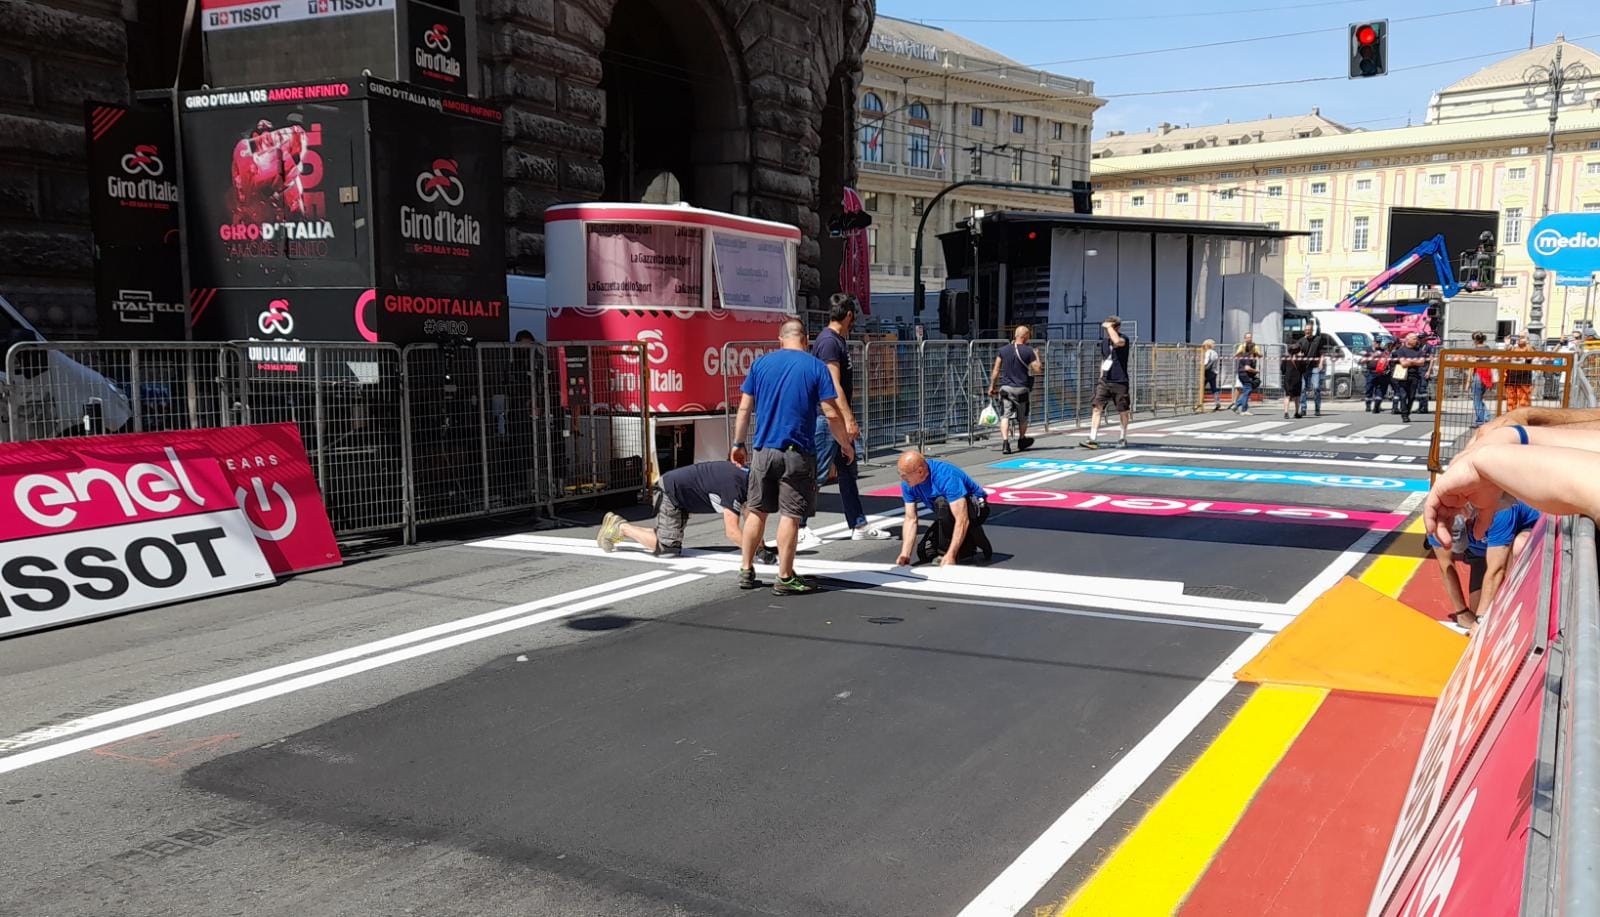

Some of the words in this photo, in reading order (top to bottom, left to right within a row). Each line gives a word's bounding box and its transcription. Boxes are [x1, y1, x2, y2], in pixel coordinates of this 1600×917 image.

[230, 5, 281, 24] TISSOT
[415, 47, 433, 69] Giro
[434, 53, 461, 78] d'Italia
[185, 93, 209, 109] GIRO
[210, 91, 250, 107] D'ITALIA
[250, 89, 268, 103] 105
[268, 86, 304, 101] AMORE
[305, 83, 349, 99] INFINITO
[369, 82, 392, 97] GIRO
[392, 88, 427, 106] D'ITALIA
[442, 98, 471, 114] AMORE
[471, 104, 503, 120] INFINITO
[107, 175, 136, 200] Giro
[138, 178, 179, 202] d'Italia
[220, 223, 260, 241] GIRO
[262, 219, 336, 240] D'TALIA
[400, 205, 433, 240] Giro
[434, 210, 481, 246] d'Italia
[433, 245, 451, 255] MAY
[631, 252, 638, 264] La
[638, 253, 664, 265] Gazzetta
[588, 281, 596, 292] La
[596, 281, 620, 293] Gazzetta
[635, 282, 652, 294] Sport
[383, 294, 502, 317] GIRODITALIA.IT
[423, 318, 469, 336] #GIRO
[216, 454, 280, 472] EARS
[14, 446, 205, 528] enel
